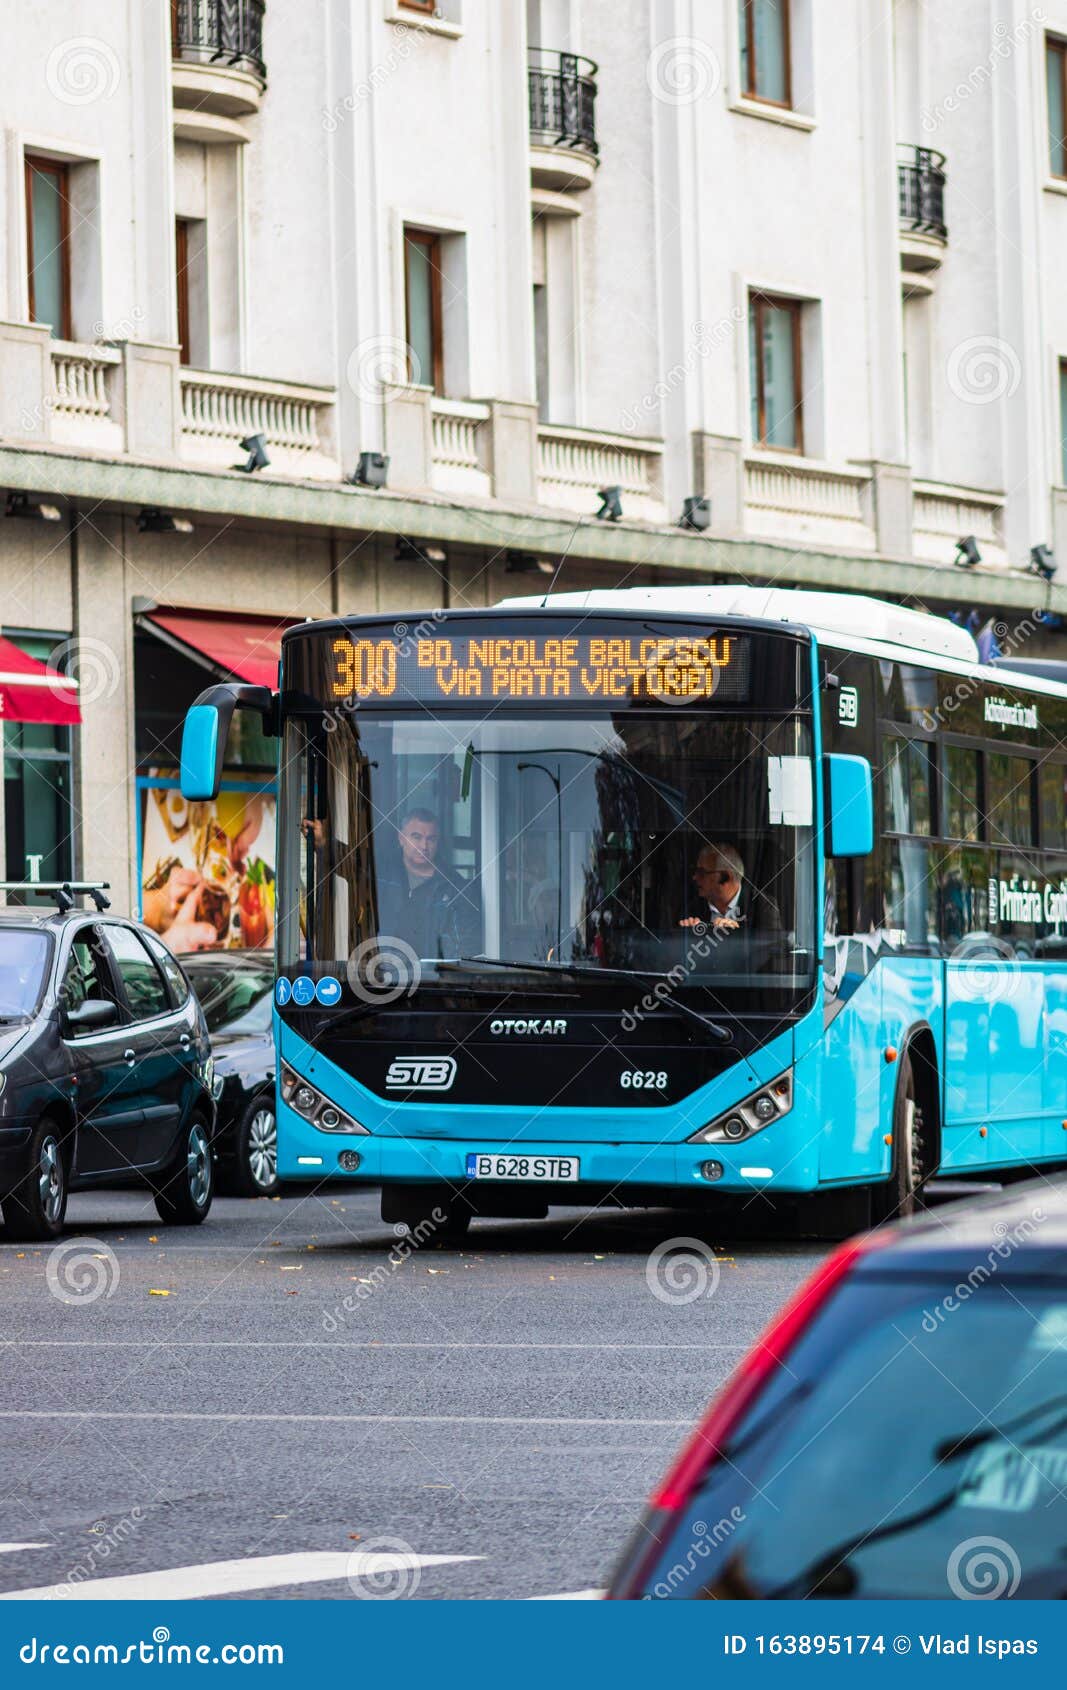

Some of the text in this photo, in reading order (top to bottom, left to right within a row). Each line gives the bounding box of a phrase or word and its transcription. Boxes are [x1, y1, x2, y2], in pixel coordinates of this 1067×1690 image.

[417, 638, 731, 667] BD. NICOLAE BALCESCU
[332, 639, 397, 696] 300
[436, 668, 713, 696] VIA PIATA VICTORIEI
[489, 1019, 568, 1035] OTOKAR
[385, 1059, 453, 1087] STB
[619, 1070, 668, 1089] 6628
[479, 1157, 572, 1178] B 628 STB
